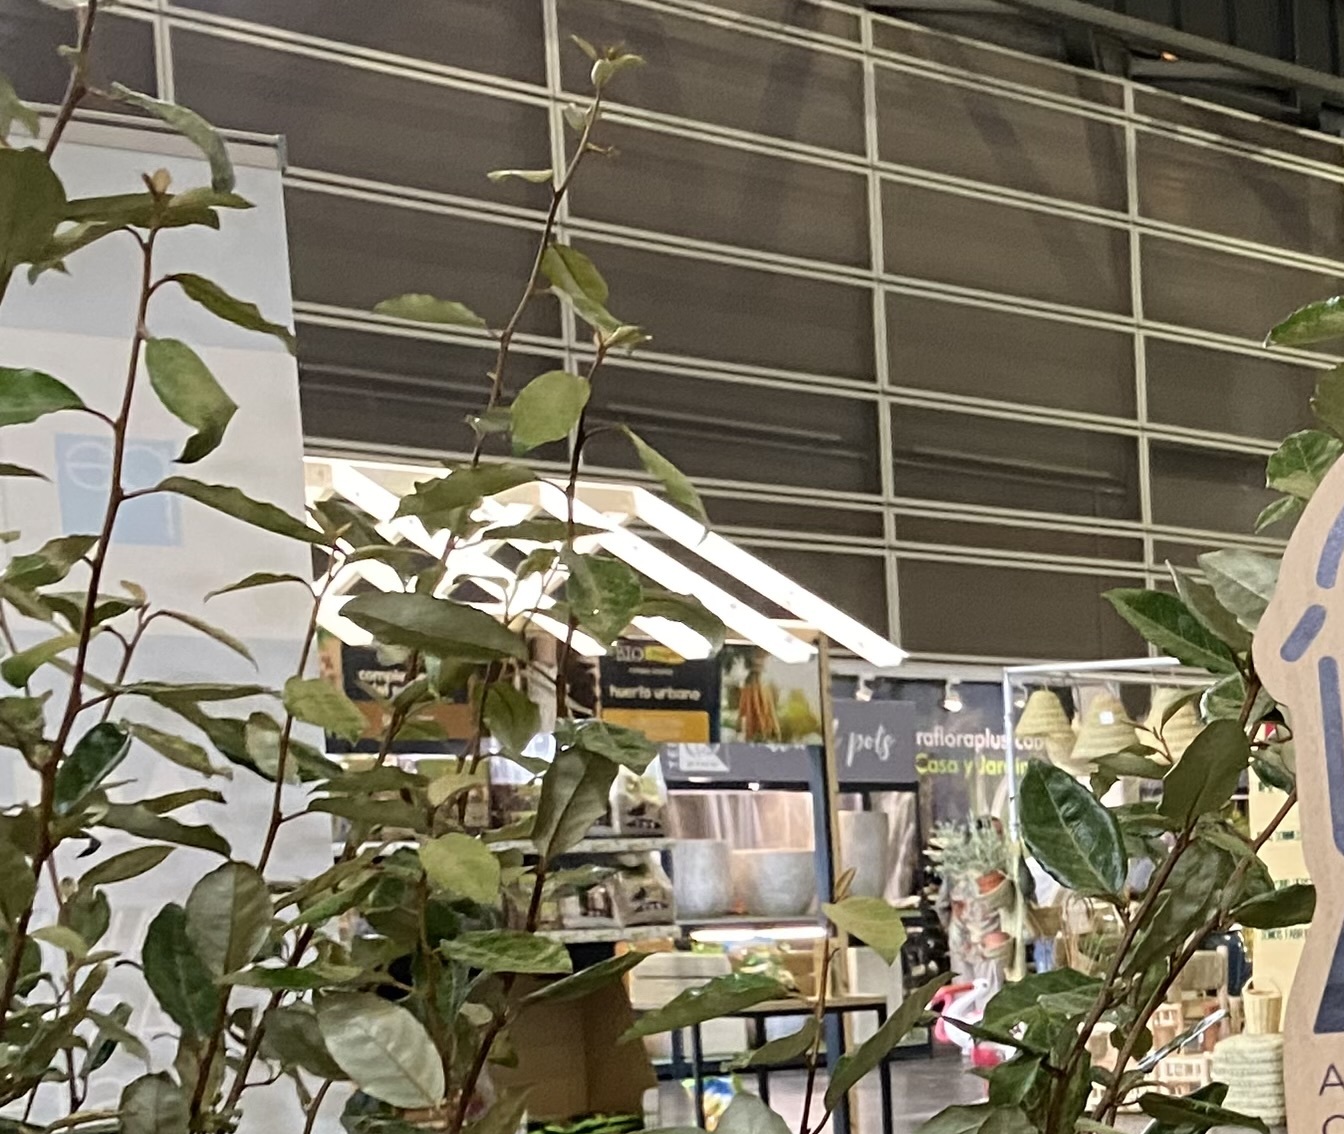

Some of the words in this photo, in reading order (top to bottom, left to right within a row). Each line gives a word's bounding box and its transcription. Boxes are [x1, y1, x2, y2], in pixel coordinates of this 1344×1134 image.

[609, 684, 651, 700] huerto
[654, 686, 701, 701] urbano
[914, 752, 959, 775] Casa
